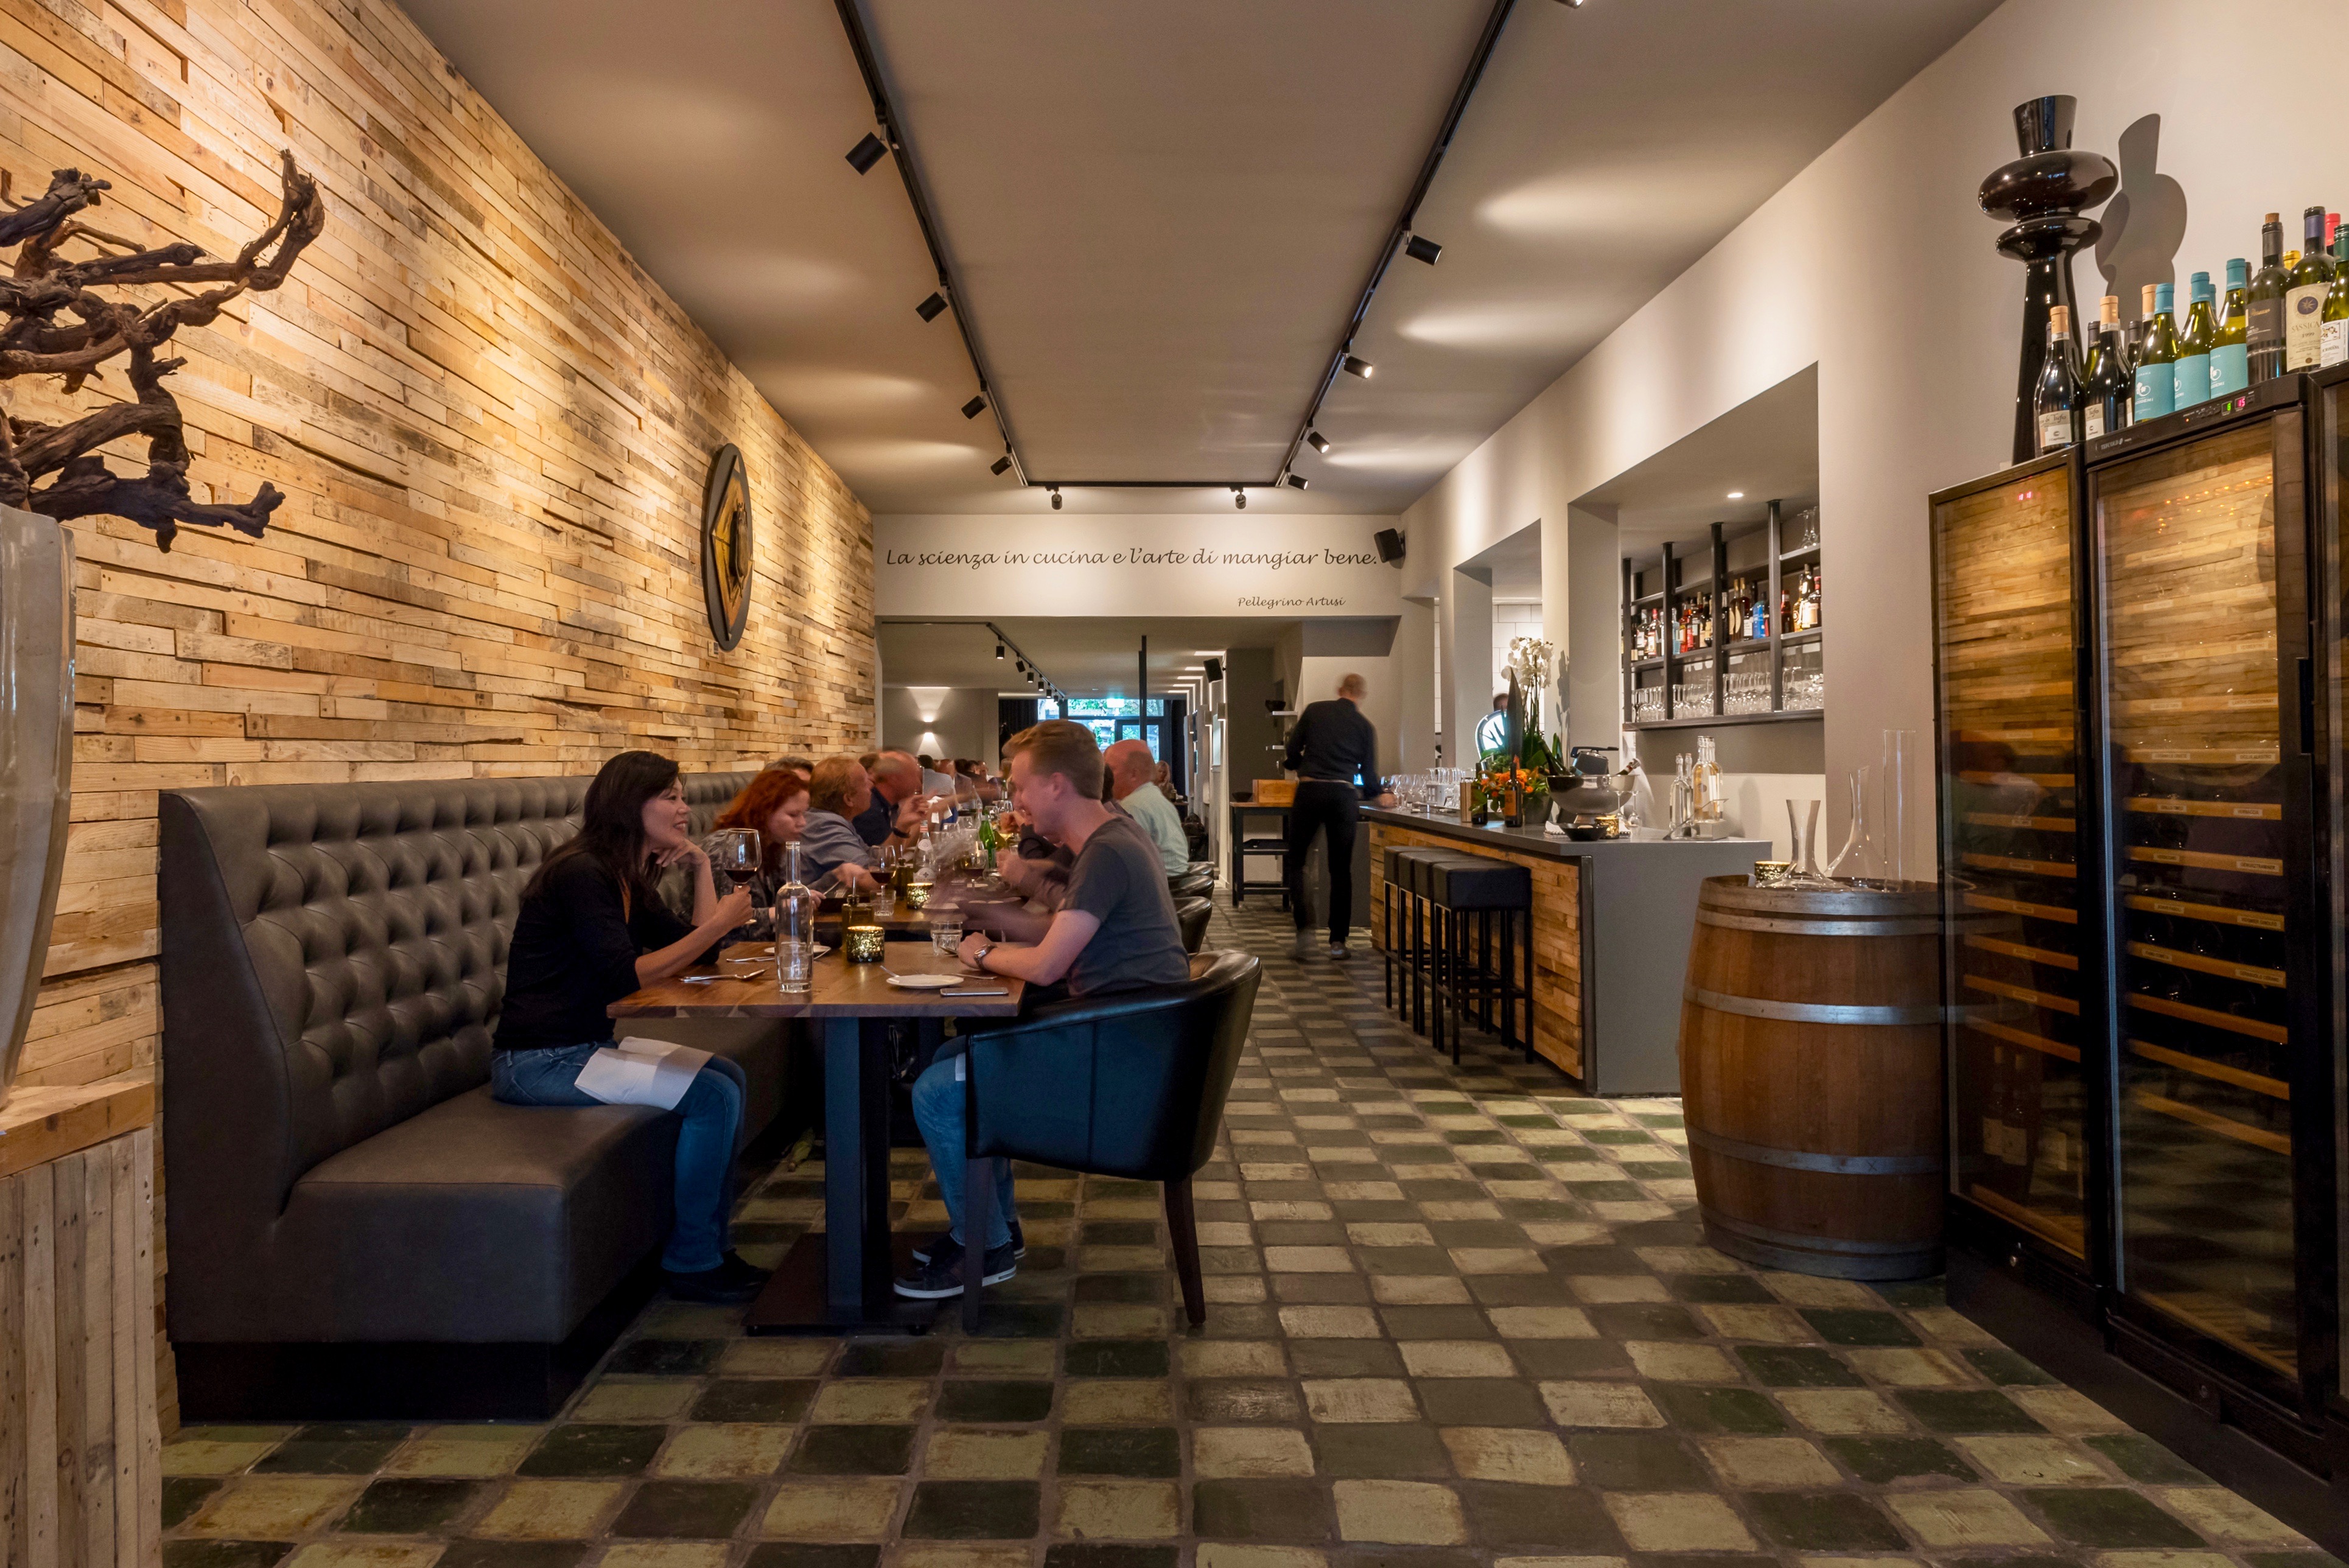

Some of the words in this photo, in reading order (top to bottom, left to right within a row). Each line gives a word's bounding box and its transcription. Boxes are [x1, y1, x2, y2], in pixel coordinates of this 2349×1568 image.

[2292, 321, 2320, 333] SASSICA
[886, 549, 915, 565] La
[918, 550, 1000, 570] scienza
[1004, 550, 1030, 565] in
[1033, 550, 1110, 565] cucina
[1112, 553, 1127, 565] e
[1130, 547, 1190, 565] l'arte
[1192, 548, 1219, 565] di
[1222, 550, 1319, 570] mangiar
[1324, 548, 1377, 565] bene.
[1238, 596, 1305, 609] Pellegrino
[1306, 597, 1346, 607] Artusi
